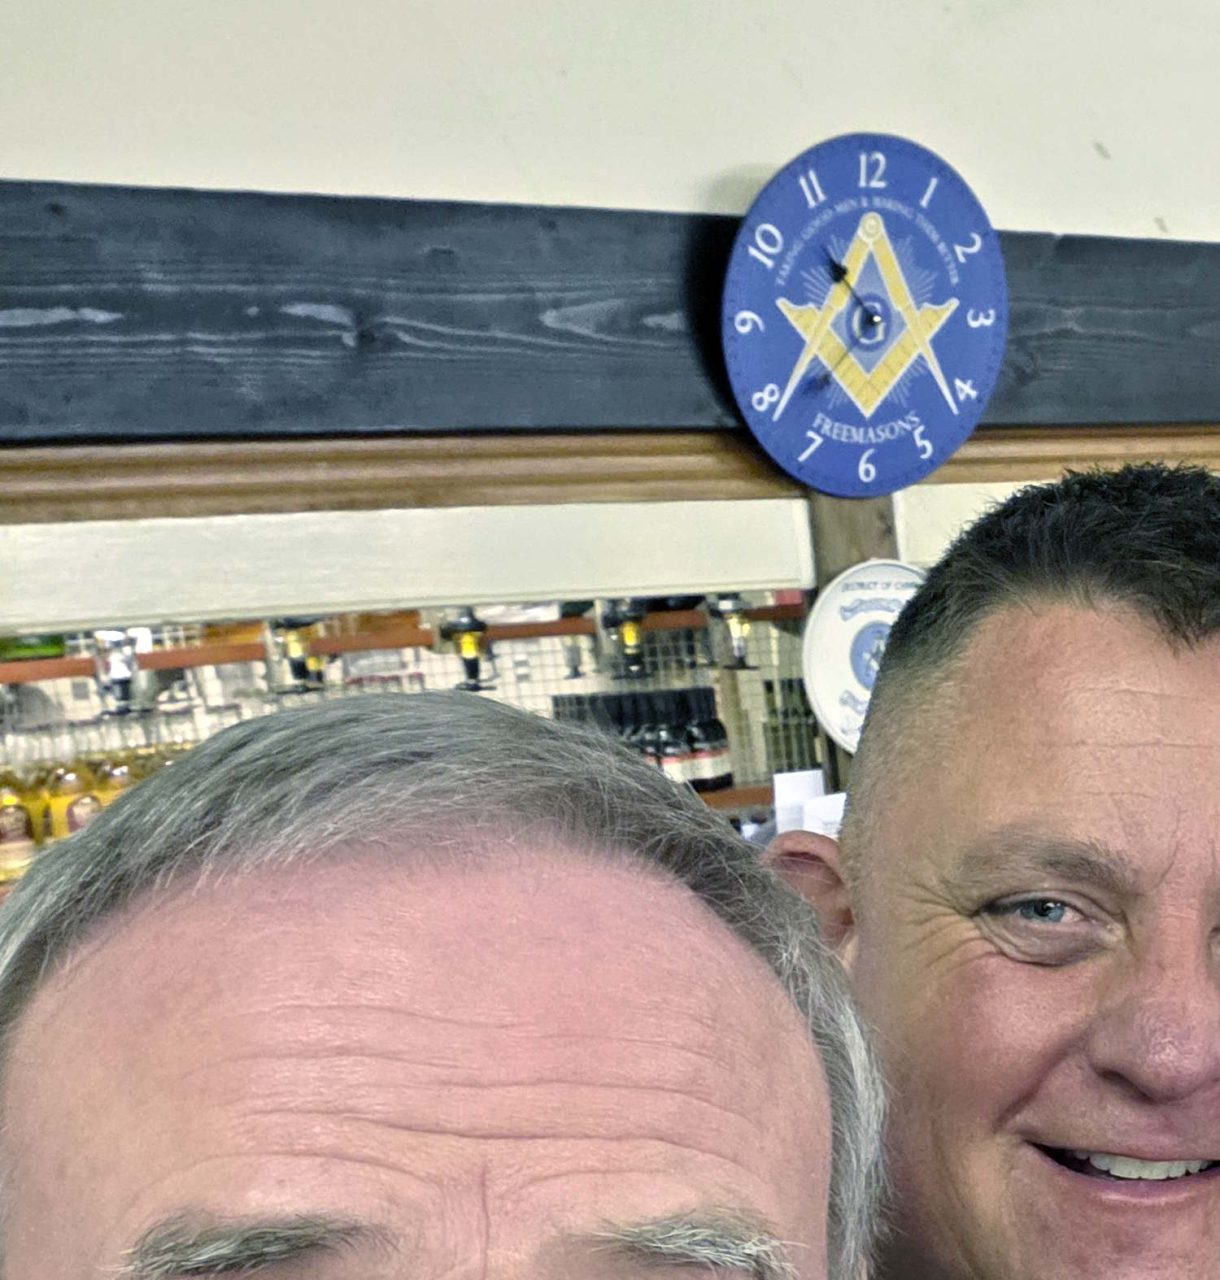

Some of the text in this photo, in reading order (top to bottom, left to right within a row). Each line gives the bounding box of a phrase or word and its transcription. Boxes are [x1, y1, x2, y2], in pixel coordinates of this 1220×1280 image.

[858, 152, 887, 188] 12
[799, 169, 826, 209] 11
[920, 177, 938, 208] 1
[748, 223, 784, 269] 10
[953, 232, 982, 263] 2
[734, 310, 765, 334] 9
[967, 308, 996, 328] 3
[751, 383, 780, 412] 8
[954, 376, 978, 404] 4
[812, 410, 920, 444] FREEMASONS
[914, 425, 933, 459] 5
[798, 431, 824, 462] 7
[858, 449, 876, 483] 6
